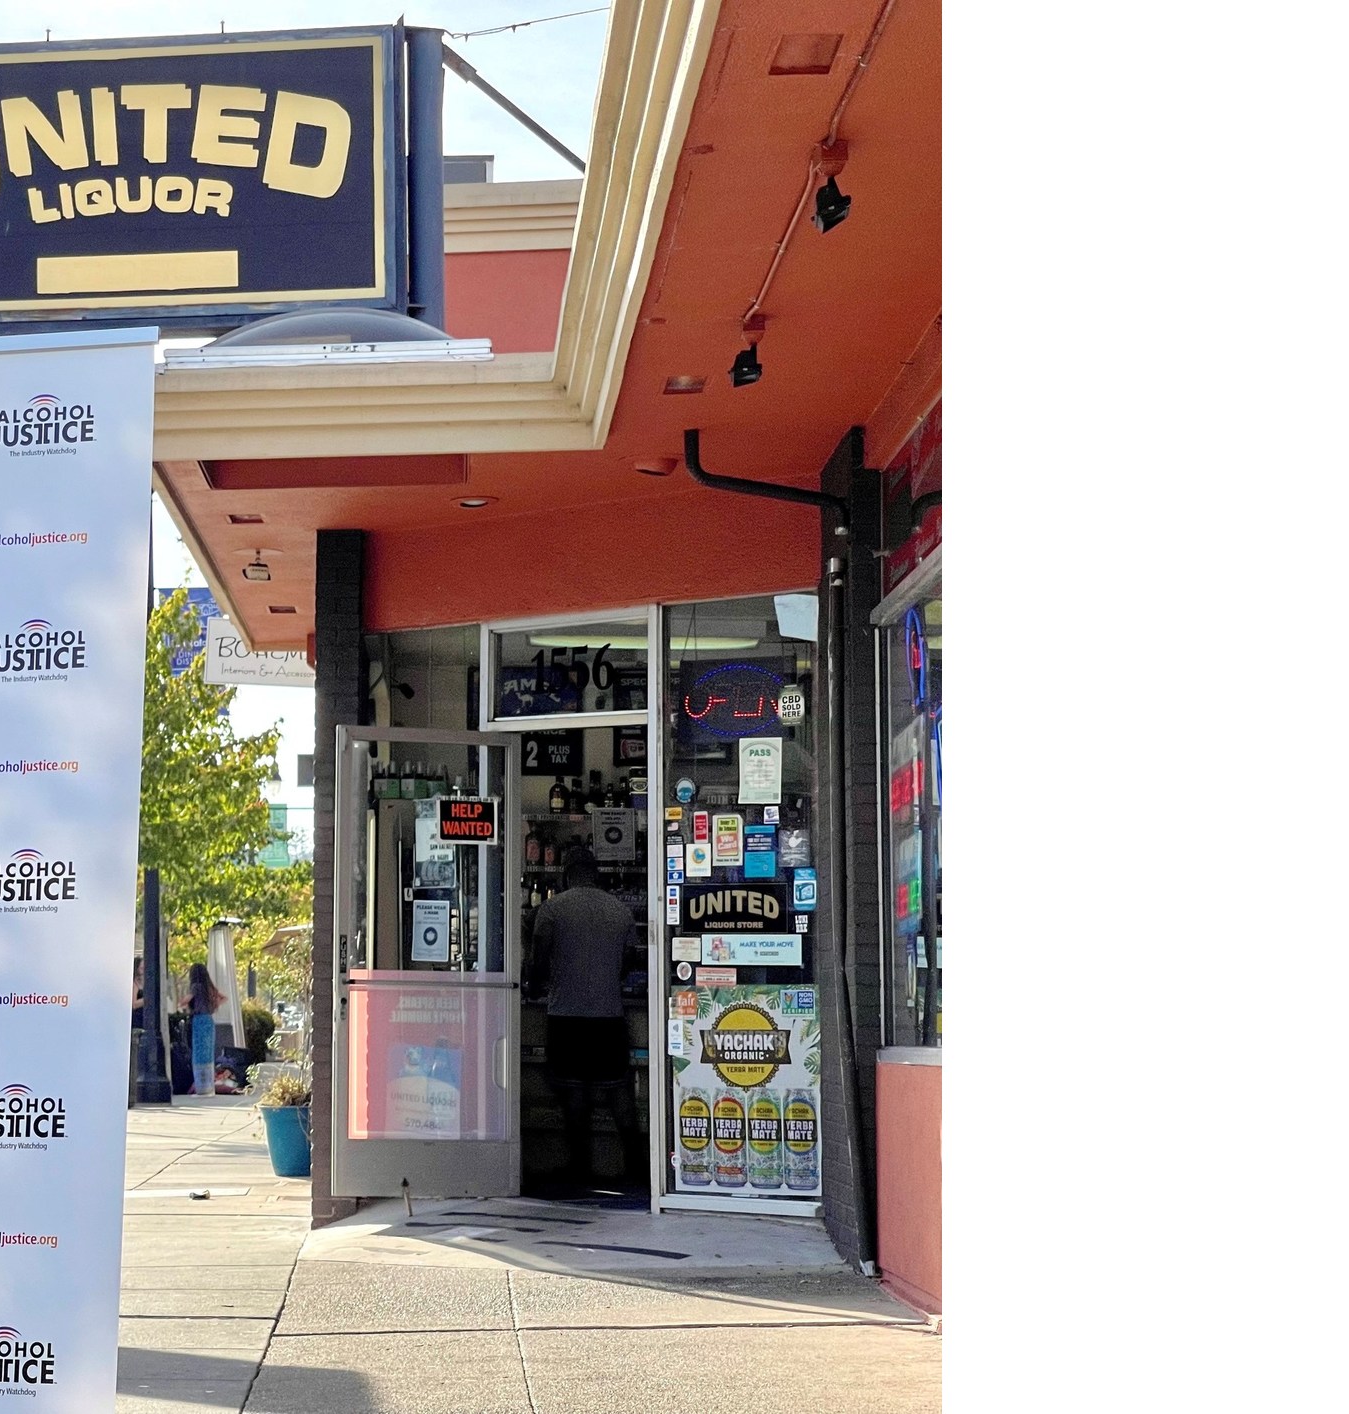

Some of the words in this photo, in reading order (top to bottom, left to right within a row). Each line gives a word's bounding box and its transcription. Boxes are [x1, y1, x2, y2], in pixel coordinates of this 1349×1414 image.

[27, 175, 234, 224] LIQUOR
[21, 449, 46, 457] Industry
[46, 447, 77, 456] Watchdog
[531, 643, 615, 692] 1556
[1, 675, 13, 683] The
[13, 675, 38, 684] Industry
[37, 673, 68, 682] Watchdog
[781, 694, 801, 704] CBD
[749, 749, 771, 757] PASS
[451, 803, 483, 818] HELP
[442, 820, 493, 836] WANTED
[3, 905, 29, 914] Industry
[28, 904, 59, 914] Watchdog
[690, 890, 780, 920] UNITED
[704, 921, 735, 929] LIQUOR
[736, 921, 764, 929] STORE
[714, 1034, 774, 1051] YACHAK
[724, 1052, 765, 1060] ORGANIC
[726, 1064, 747, 1073] YERBA
[748, 1064, 765, 1073] MATE
[681, 1118, 708, 1127] YERBA
[715, 1119, 742, 1129] YERBA
[750, 1120, 778, 1130] YERBA
[785, 1121, 814, 1130] YERBA
[683, 1127, 707, 1137] MATE
[716, 1129, 741, 1138] MATE
[751, 1130, 777, 1139] MATE
[787, 1130, 812, 1140] MATE
[17, 1142, 48, 1152] Watchdog
[5, 1387, 37, 1398] Watchdog
